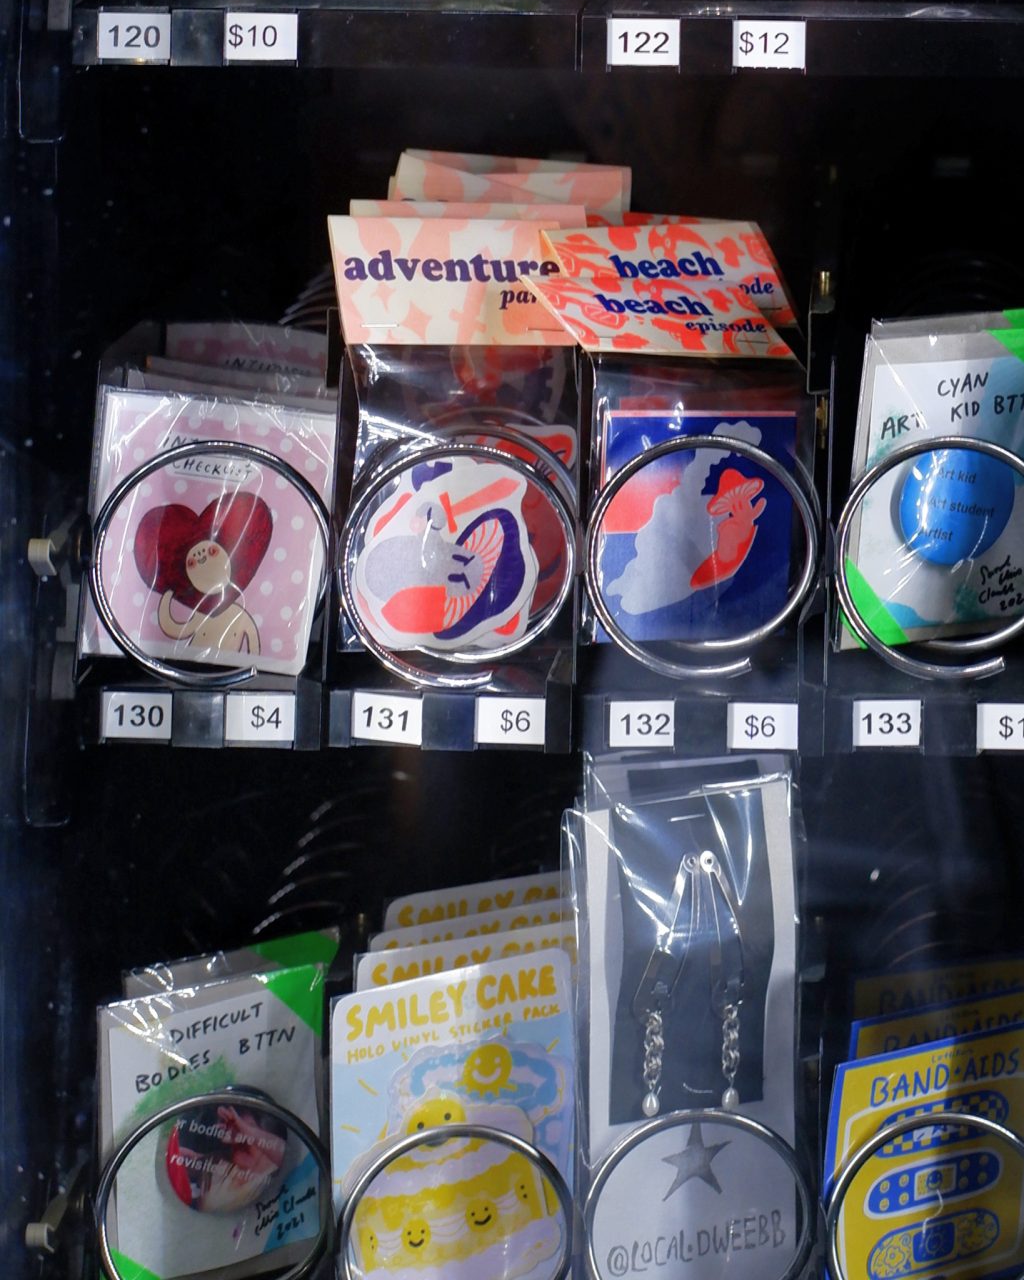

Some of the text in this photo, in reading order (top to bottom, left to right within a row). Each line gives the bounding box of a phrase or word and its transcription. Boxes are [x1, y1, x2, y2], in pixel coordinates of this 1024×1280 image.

[109, 25, 160, 47] 120
[228, 24, 277, 48] $10
[619, 32, 669, 53] 122
[740, 32, 788, 55] $12
[343, 250, 560, 283] adventure
[609, 251, 724, 281] beach
[594, 294, 713, 316] beach
[685, 319, 767, 335] episode
[937, 372, 990, 399] CYAN
[951, 399, 981, 421] KID
[958, 472, 977, 484] kid
[950, 501, 996, 517] student
[115, 705, 163, 727] 130
[251, 706, 281, 728] $4
[363, 706, 408, 731] 131
[501, 710, 530, 733] $6
[621, 714, 668, 735] 132
[745, 715, 775, 739] $6
[863, 713, 911, 734] 133
[346, 964, 557, 1042] SMILEY CAKE
[171, 1002, 263, 1045] DIFFICULT
[347, 1043, 385, 1065] HOLO
[392, 1030, 440, 1052] VINYL
[523, 1003, 560, 1020] PACK
[135, 1026, 297, 1093] BODIES BTTN
[189, 1120, 233, 1140] bodies
